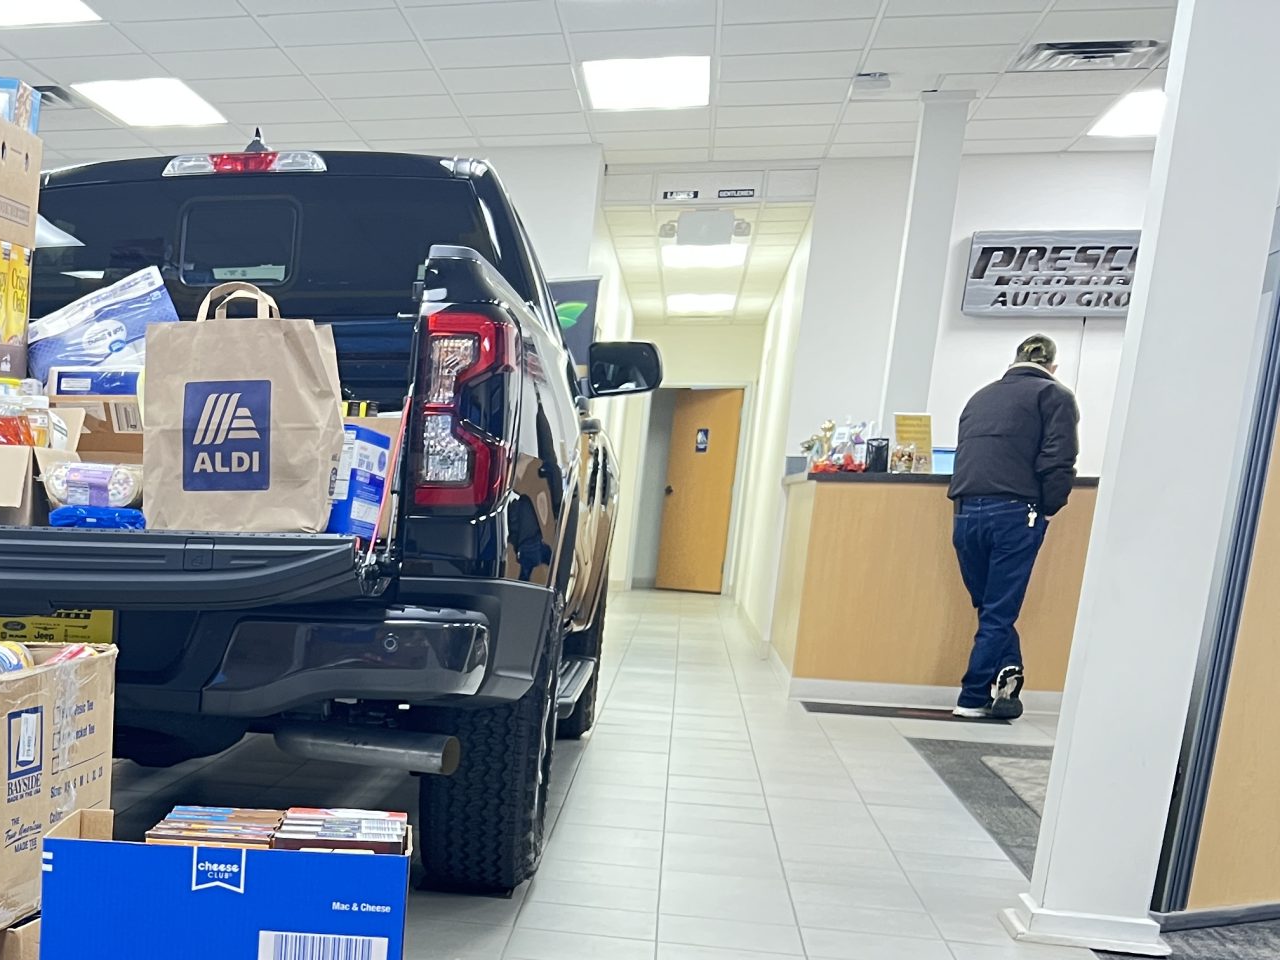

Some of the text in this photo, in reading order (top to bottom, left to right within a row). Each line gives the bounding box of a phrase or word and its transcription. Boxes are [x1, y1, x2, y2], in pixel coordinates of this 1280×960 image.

[1008, 275, 1133, 286] BROTHE
[12, 291, 26, 314] Oats
[990, 291, 1067, 307] AUTO
[193, 452, 259, 473] ALDI
[34, 632, 54, 641] Jeep
[7, 774, 42, 796] BAYSIDE
[11, 817, 20, 826] THE
[14, 841, 28, 852] MADE
[198, 861, 239, 873] cheese
[332, 902, 391, 913] Mac & Cheese
